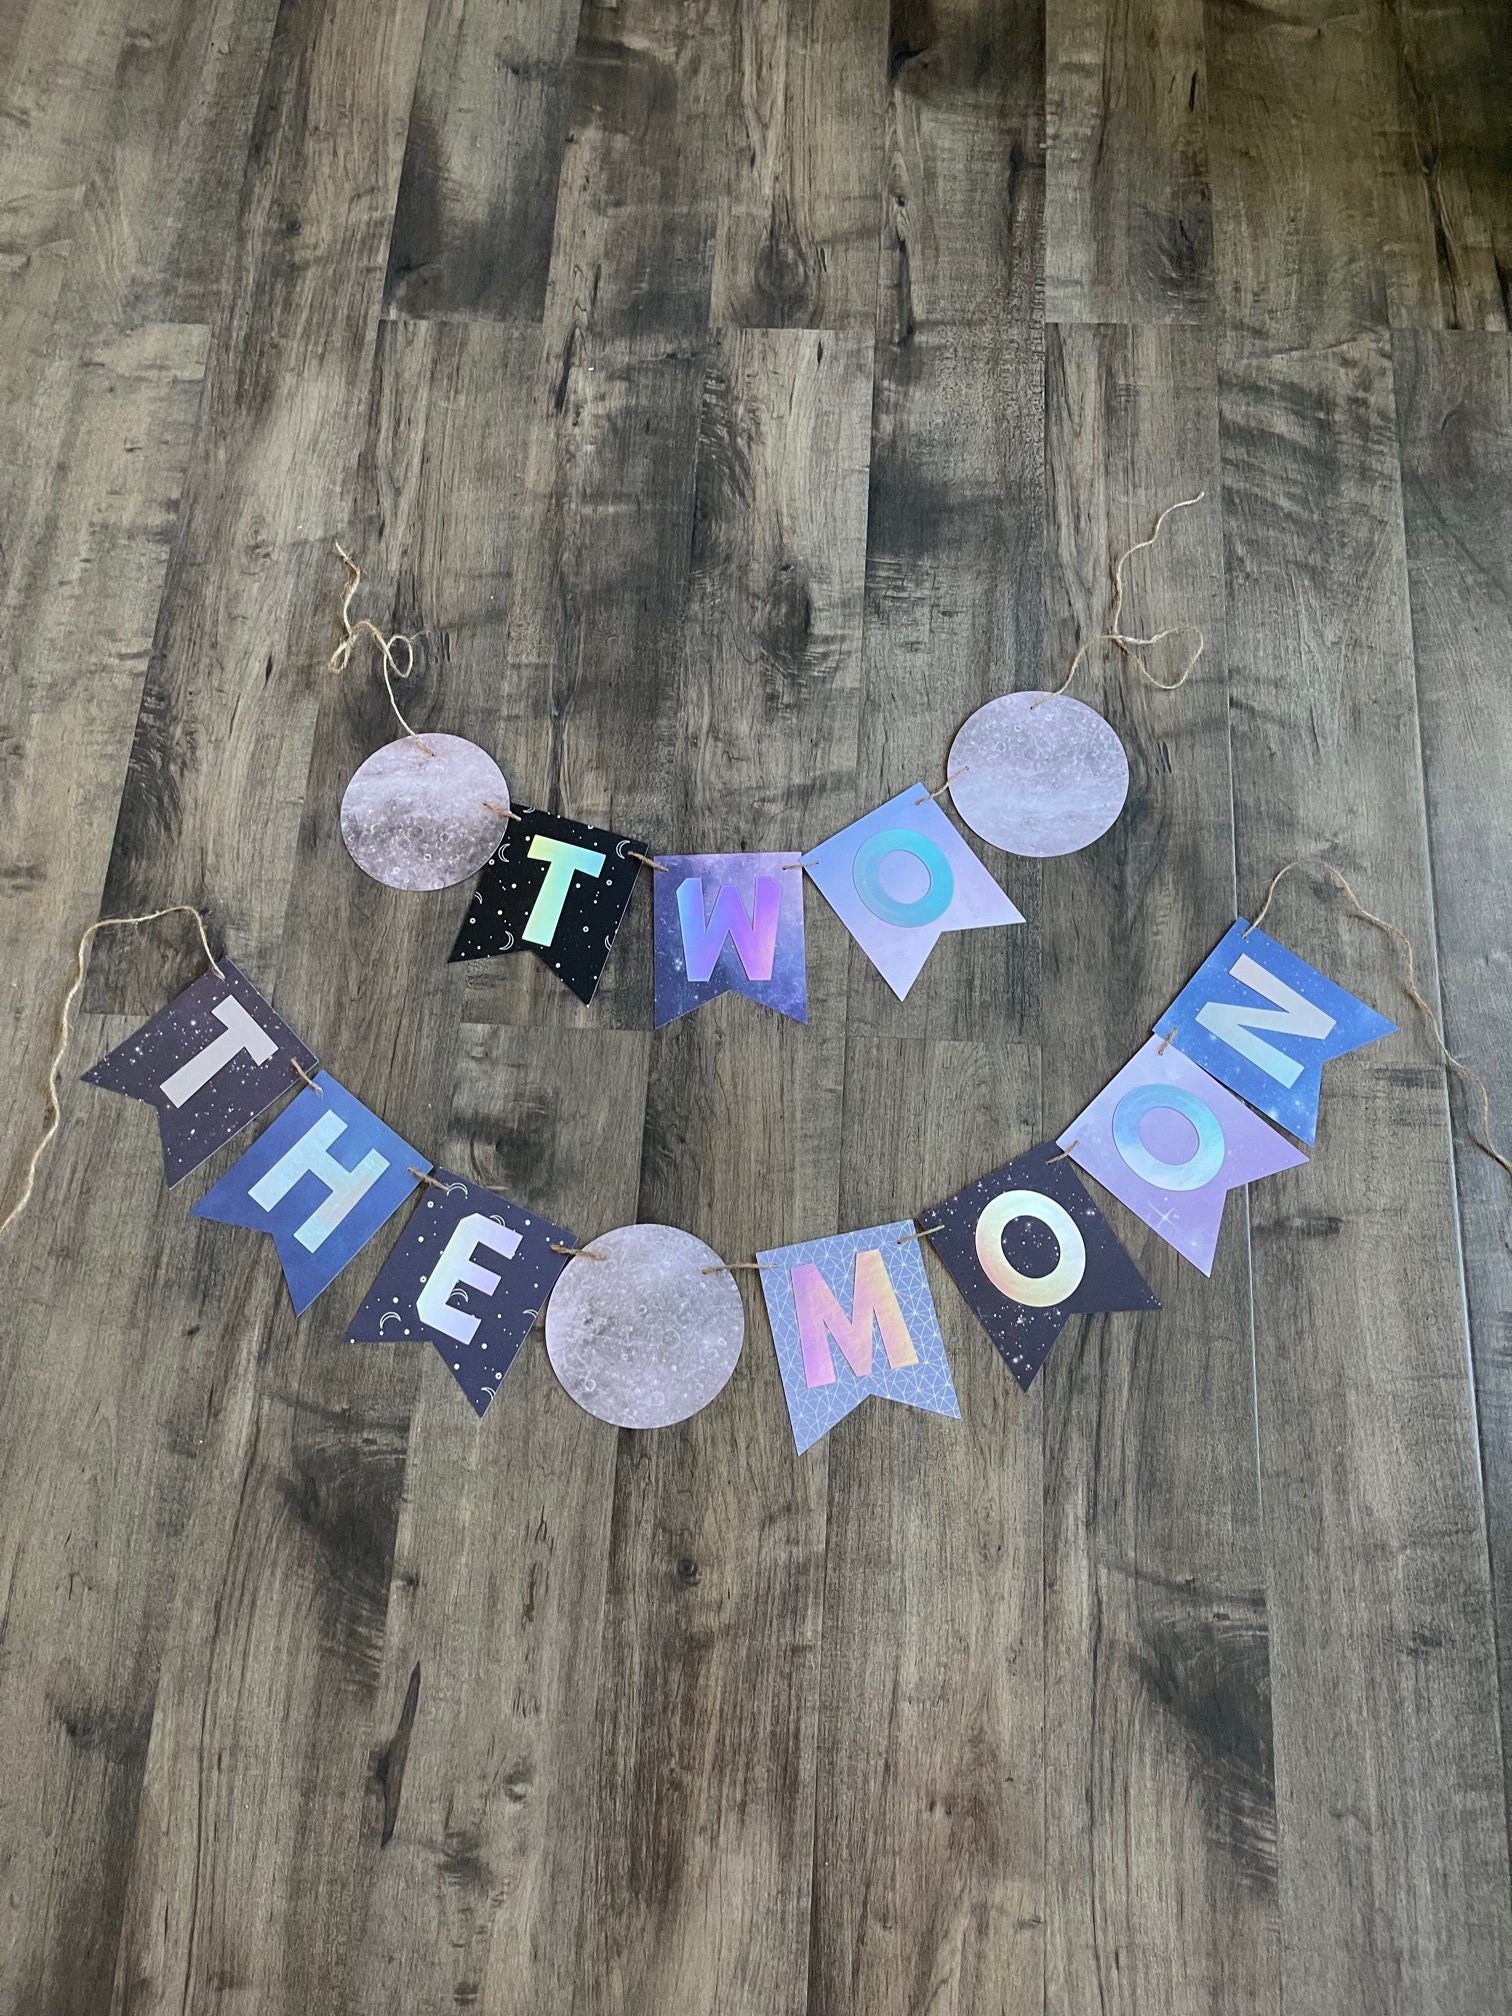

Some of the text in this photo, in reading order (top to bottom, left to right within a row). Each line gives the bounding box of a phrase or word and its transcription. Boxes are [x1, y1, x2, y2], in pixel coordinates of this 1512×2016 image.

[522, 828, 955, 982] TWO
[159, 953, 1337, 1388] THE MOON
